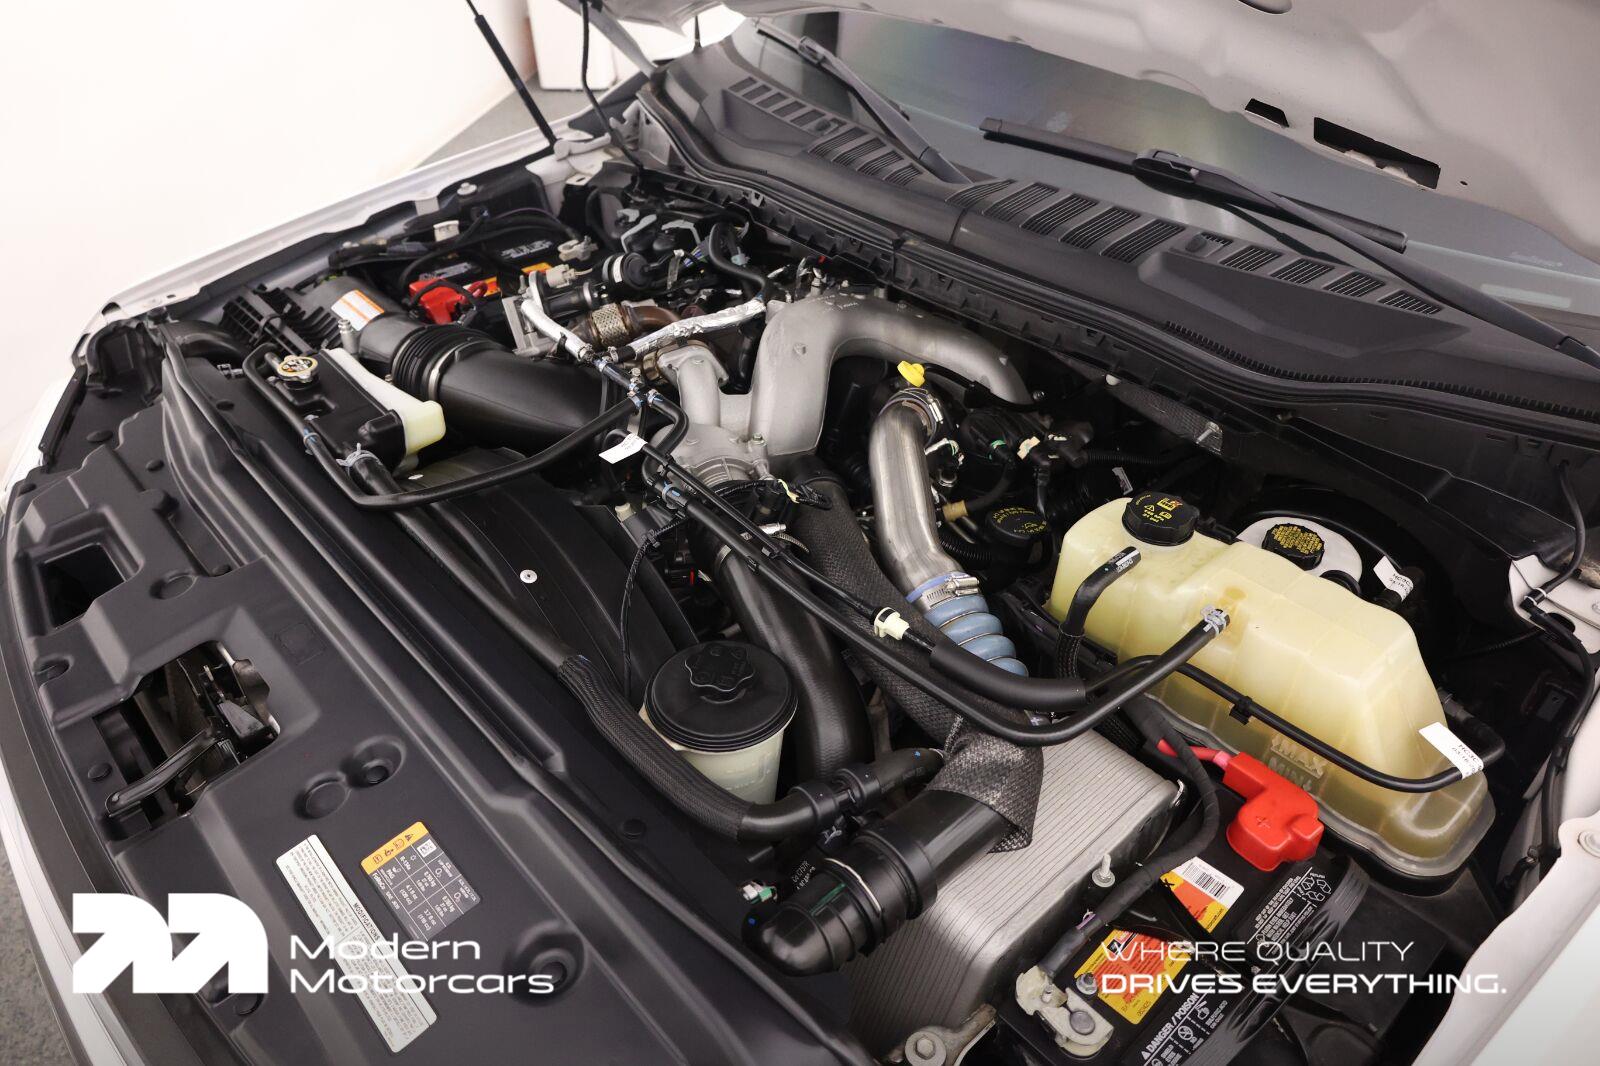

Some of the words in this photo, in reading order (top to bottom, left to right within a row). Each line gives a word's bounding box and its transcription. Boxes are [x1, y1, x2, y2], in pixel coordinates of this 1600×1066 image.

[352, 902, 380, 941] MODIFICATIONS
[1145, 1021, 1174, 1053] DANGER
[1173, 991, 1199, 1020] POISON
